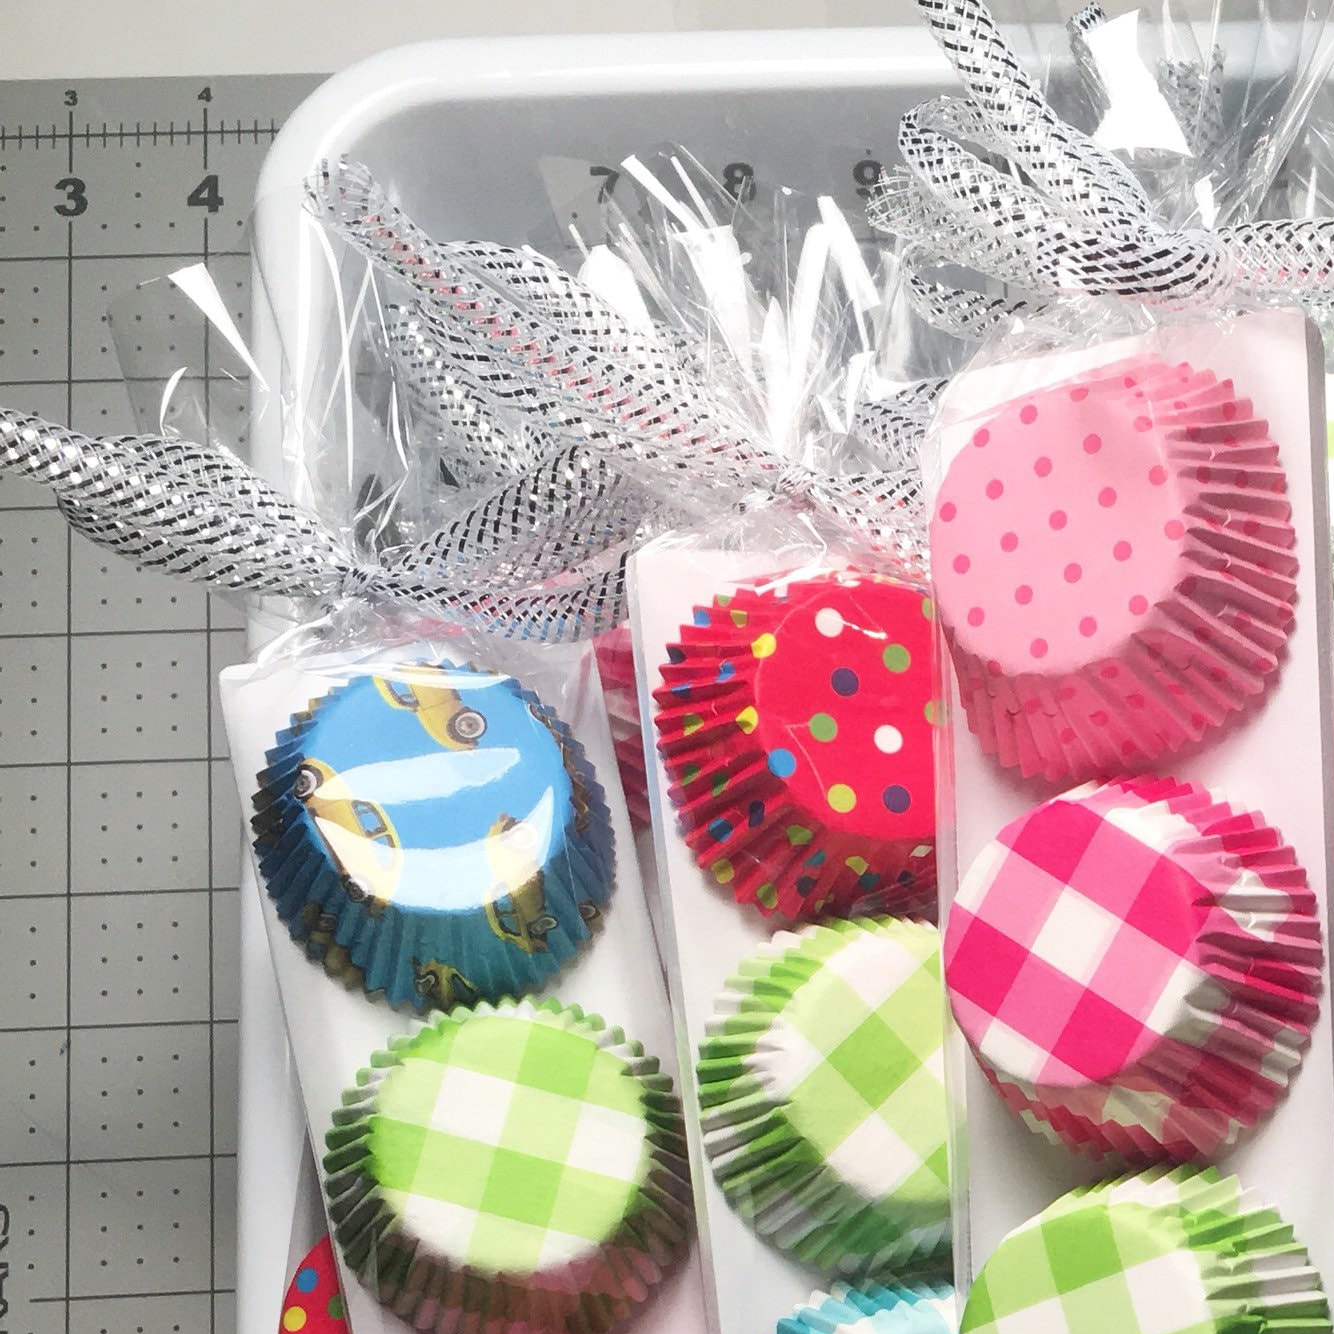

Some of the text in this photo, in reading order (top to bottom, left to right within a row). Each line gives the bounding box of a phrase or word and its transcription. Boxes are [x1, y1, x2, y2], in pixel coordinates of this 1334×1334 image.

[64, 89, 79, 107] 3
[197, 86, 214, 103] 4
[54, 176, 89, 217] 3
[186, 173, 225, 214] 4
[723, 162, 758, 202] 8
